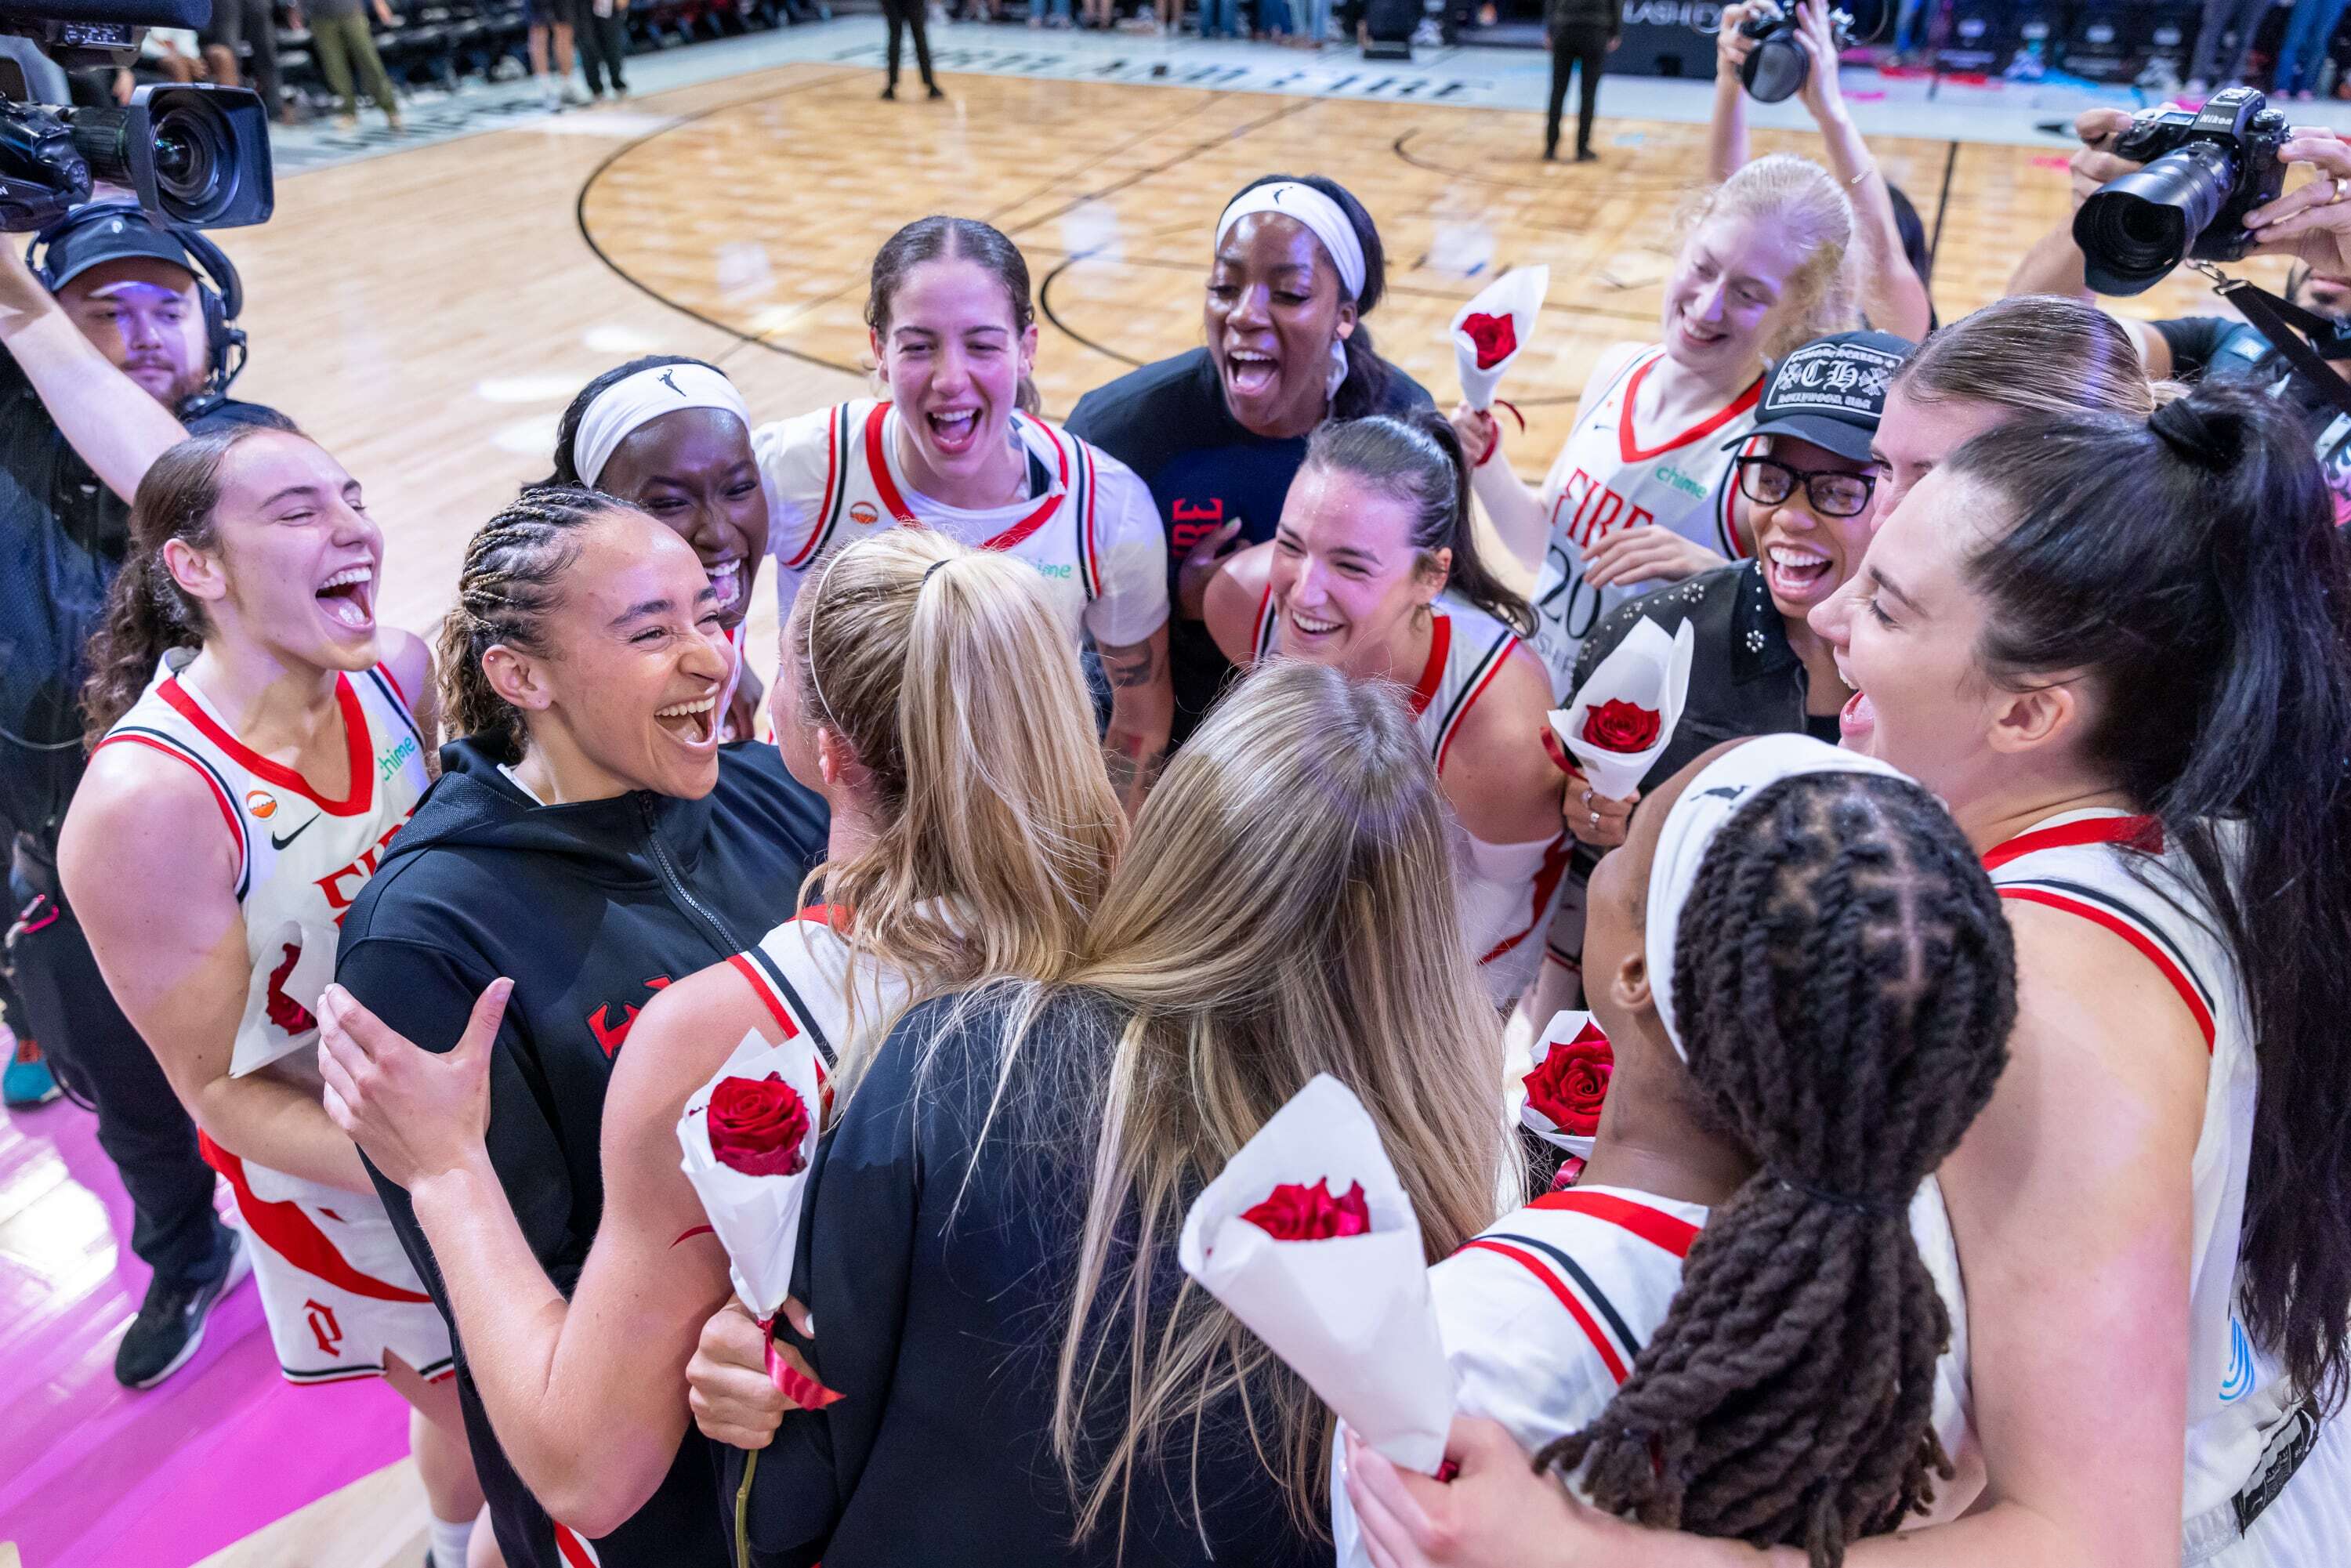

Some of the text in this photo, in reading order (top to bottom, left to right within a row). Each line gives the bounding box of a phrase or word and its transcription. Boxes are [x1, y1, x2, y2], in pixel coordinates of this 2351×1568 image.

[2199, 114, 2233, 125] Nikon
[1655, 465, 1708, 500] chime
[1539, 545, 1602, 639] 20
